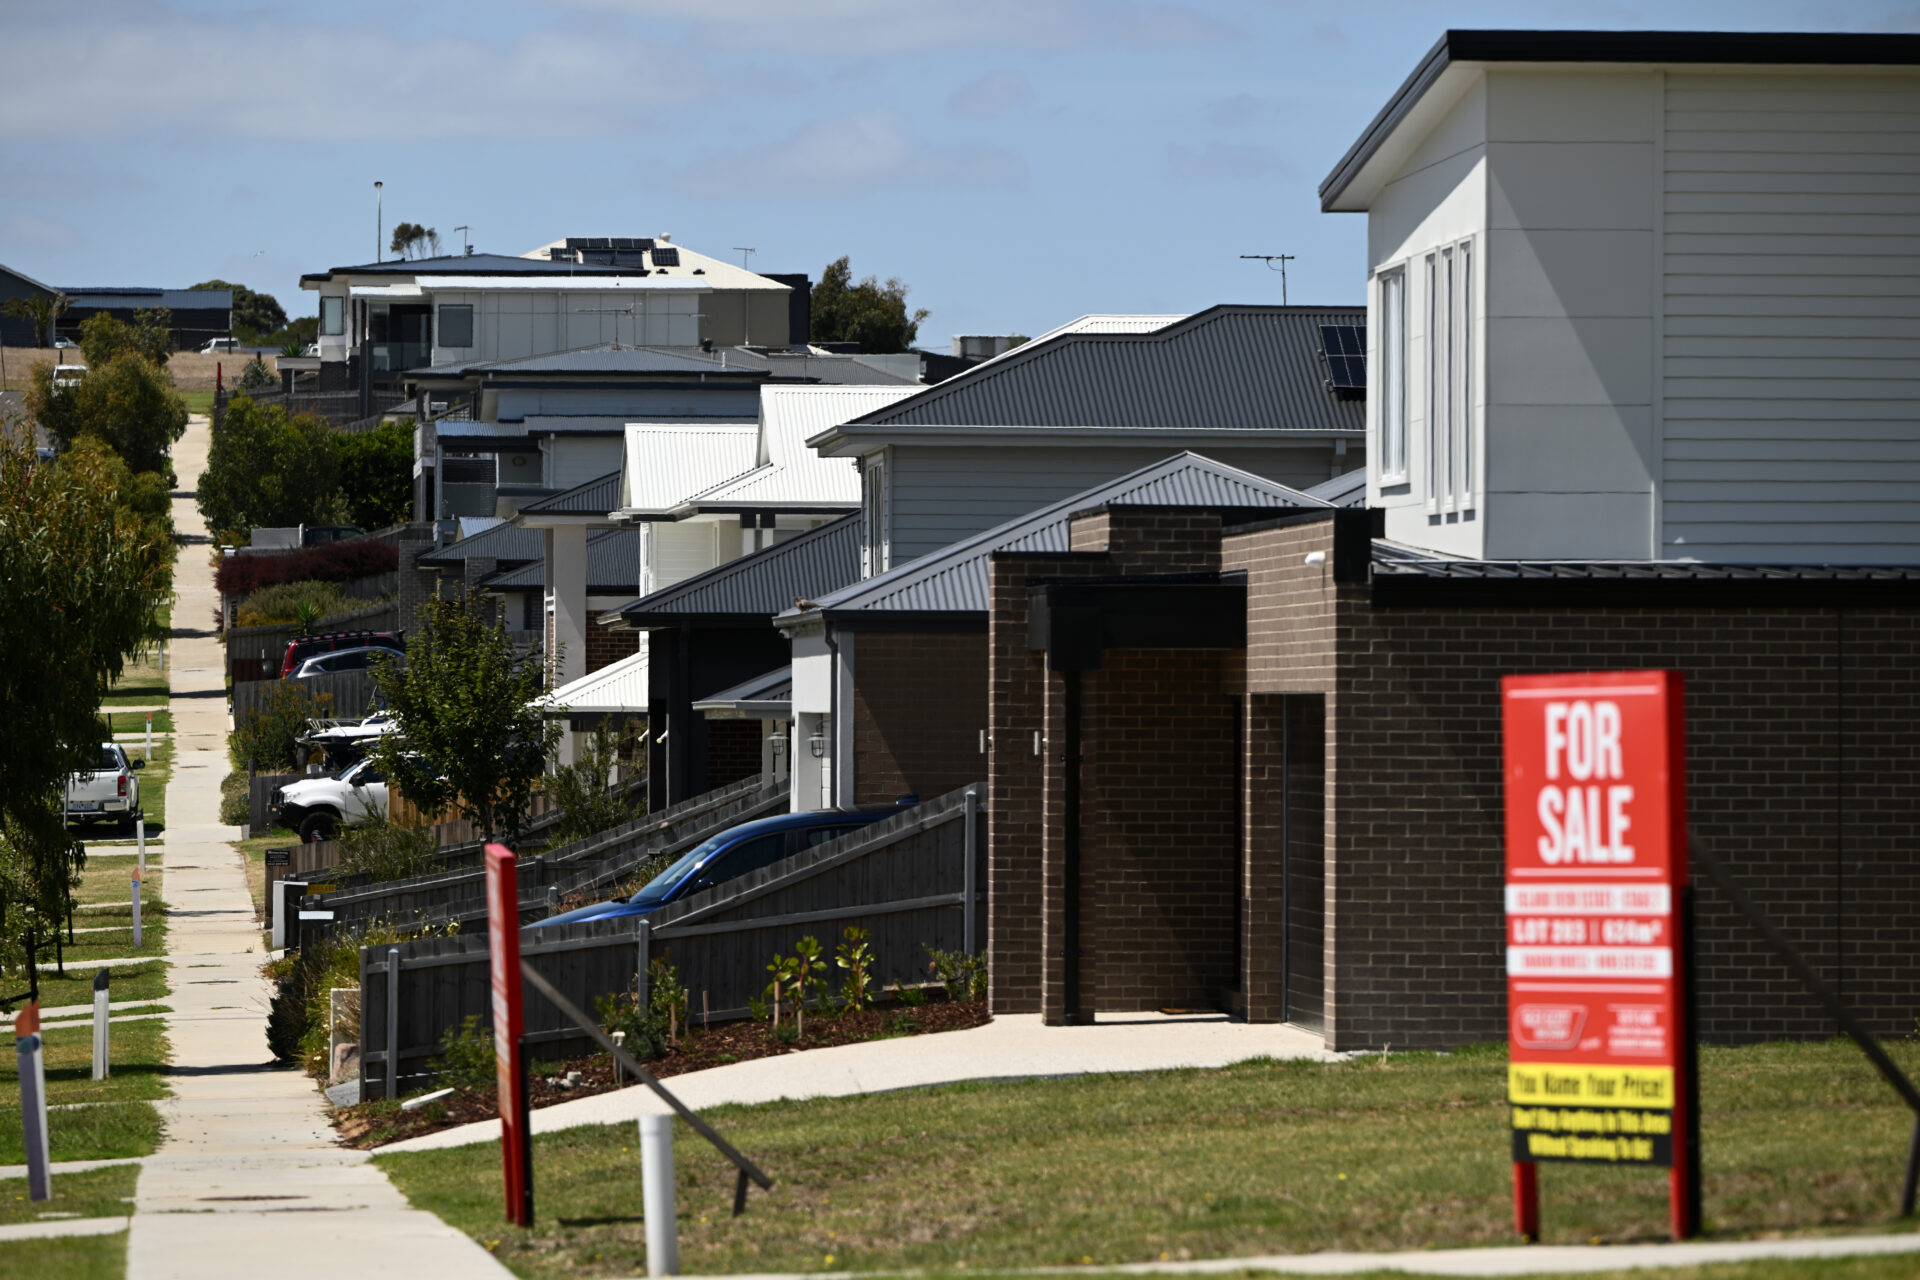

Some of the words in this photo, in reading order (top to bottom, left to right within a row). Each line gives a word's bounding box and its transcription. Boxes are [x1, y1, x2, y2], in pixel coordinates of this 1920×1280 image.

[1545, 700, 1623, 780] FOR
[1537, 785, 1635, 864] SALE
[1513, 918, 1548, 943] LOT
[1515, 1072, 1537, 1094] You
[1544, 1072, 1580, 1095] Name
[1587, 1073, 1616, 1096] Your
[1623, 1074, 1664, 1098] Price!
